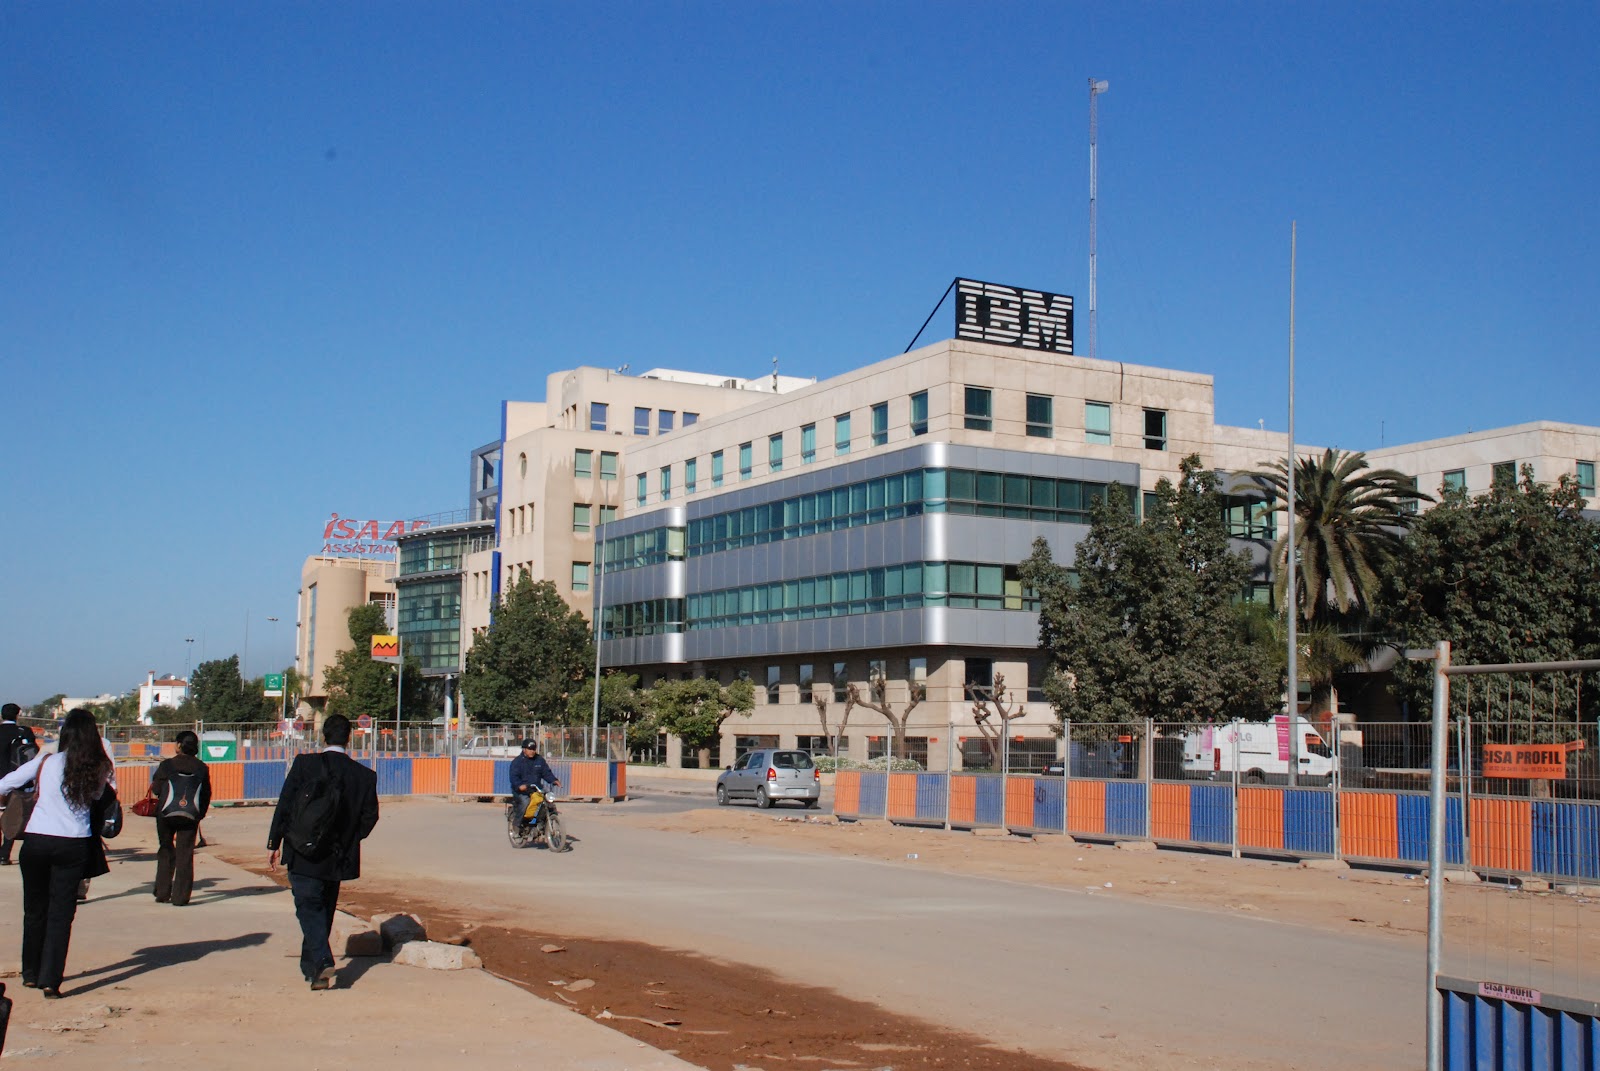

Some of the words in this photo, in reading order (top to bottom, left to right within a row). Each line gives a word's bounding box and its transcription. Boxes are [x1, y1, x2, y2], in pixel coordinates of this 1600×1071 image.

[959, 279, 1073, 353] IBM
[1240, 732, 1252, 742] LG
[1482, 750, 1512, 764] CISA
[1516, 751, 1561, 764] PROFIL
[1484, 983, 1503, 992] CISA
[1504, 986, 1533, 998] PROFIL
